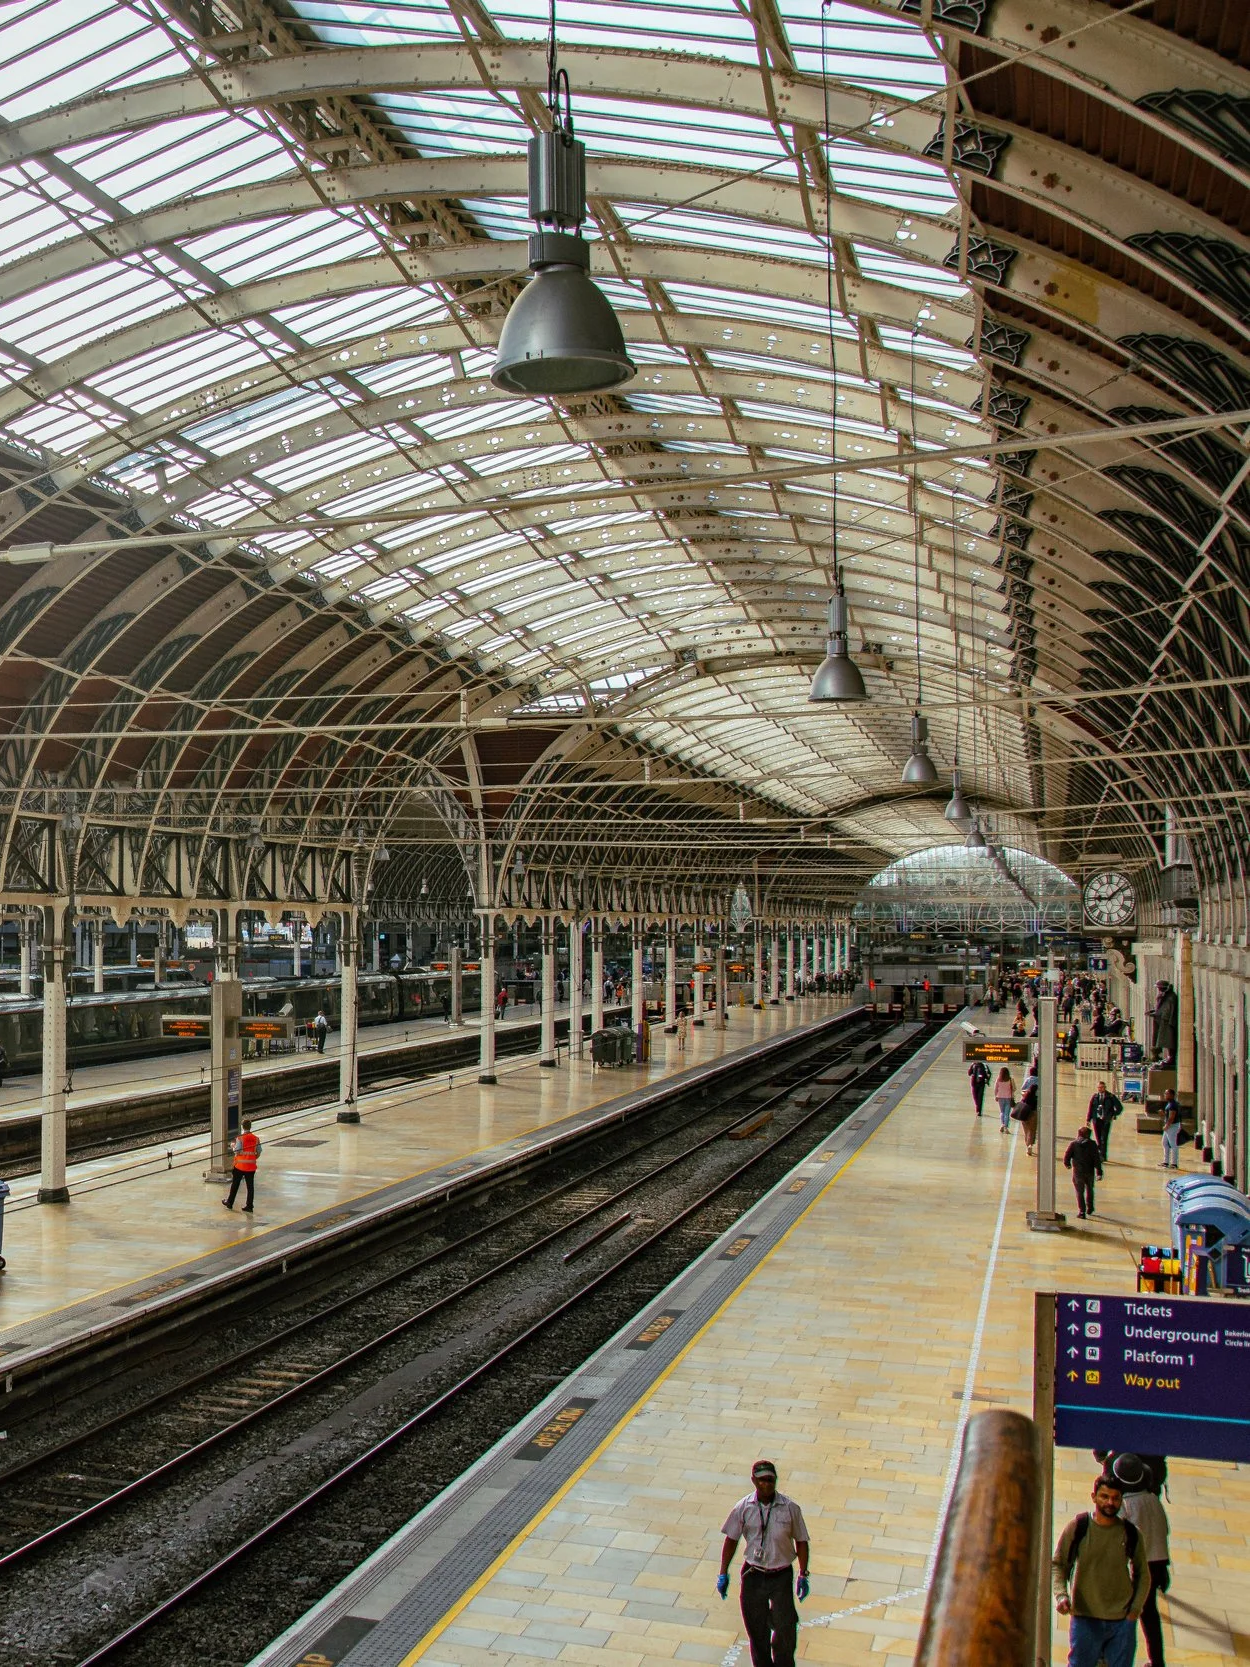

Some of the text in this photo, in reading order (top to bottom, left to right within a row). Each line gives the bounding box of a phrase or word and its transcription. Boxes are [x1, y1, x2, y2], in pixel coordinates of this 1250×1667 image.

[1124, 1303, 1172, 1318] Tickets
[1124, 1325, 1218, 1344] Underground
[1124, 1350, 1194, 1366] Platform 1
[1124, 1373, 1180, 1390] Way out
